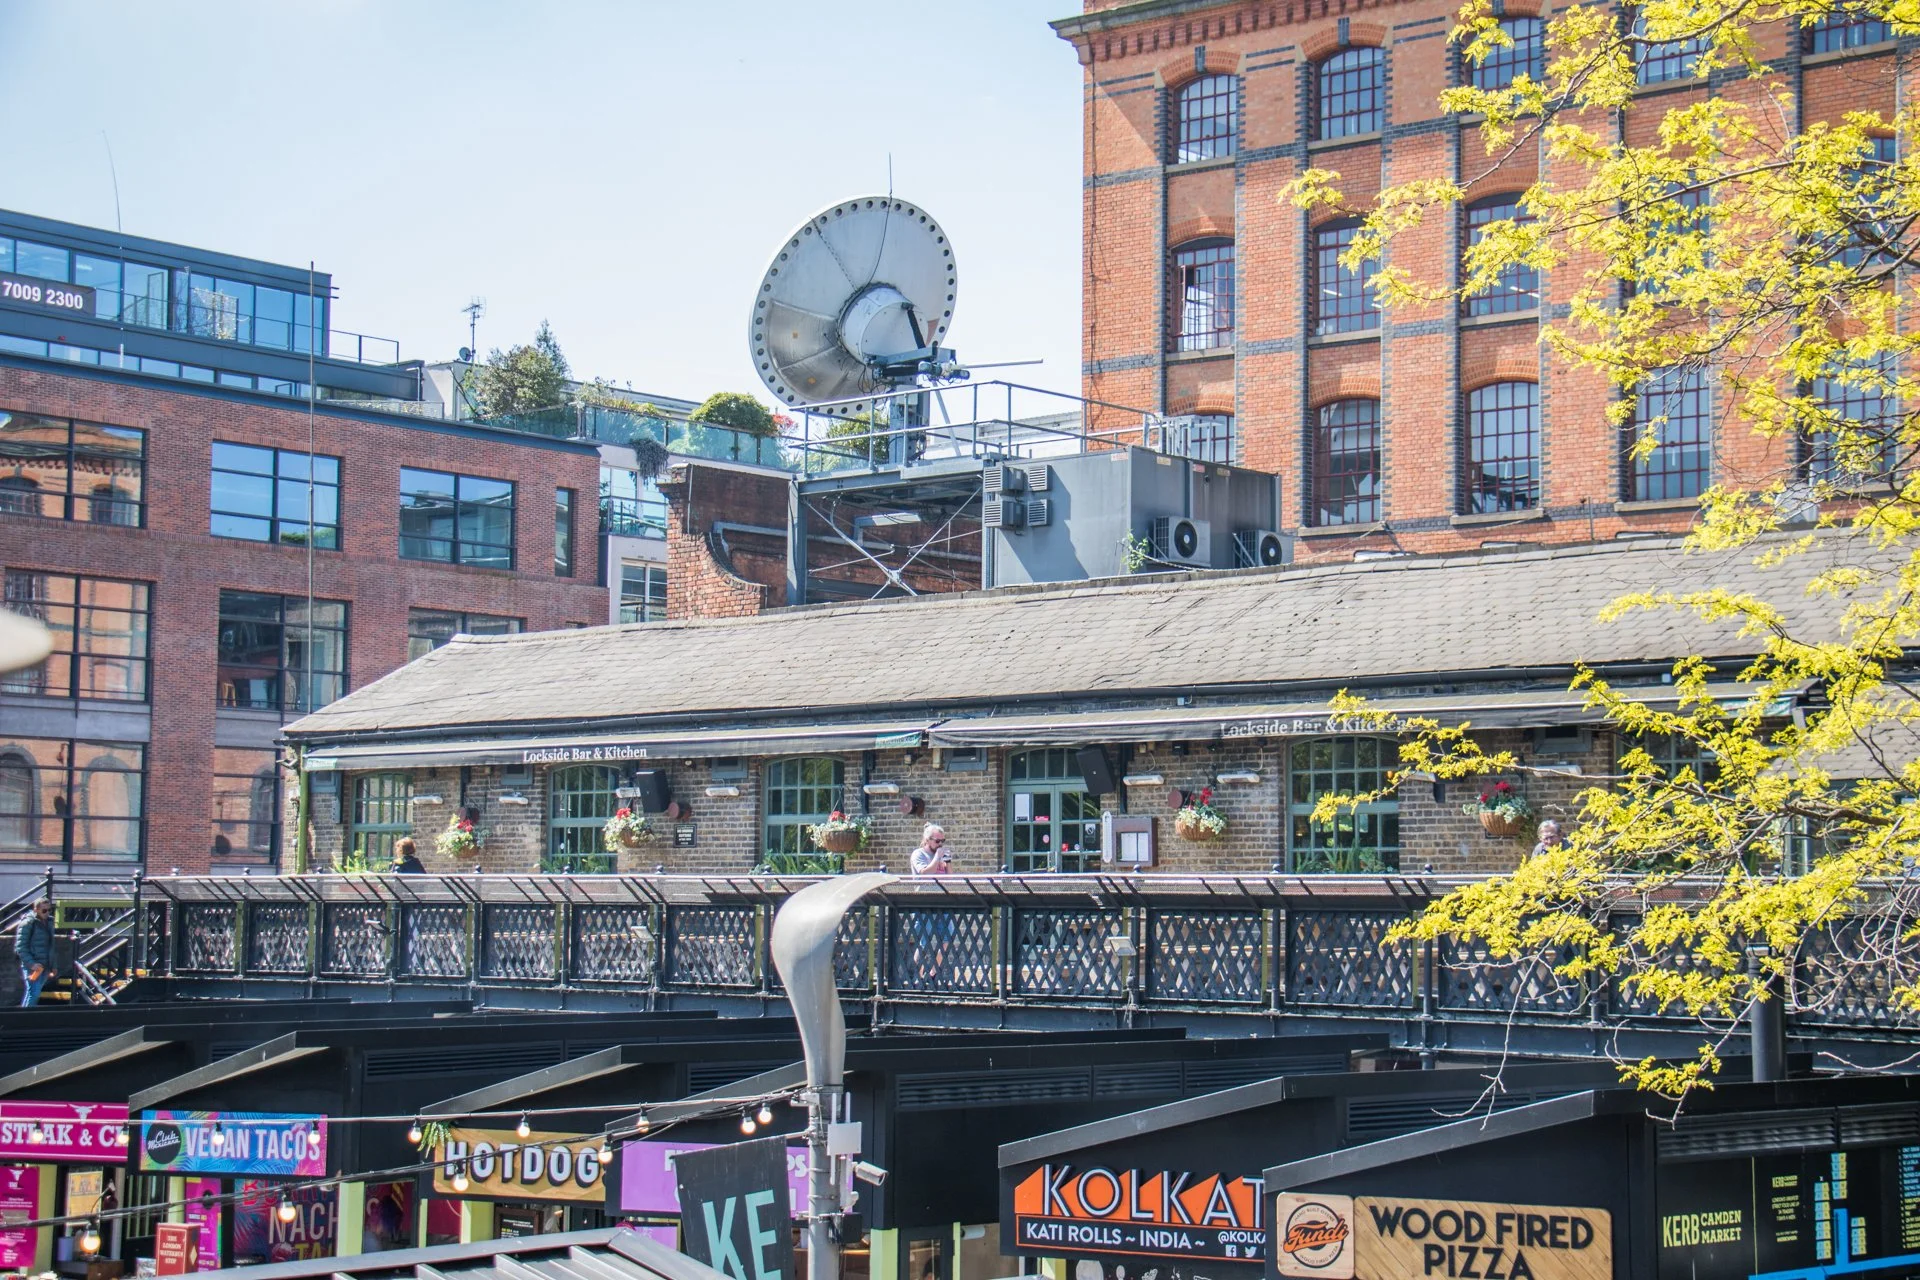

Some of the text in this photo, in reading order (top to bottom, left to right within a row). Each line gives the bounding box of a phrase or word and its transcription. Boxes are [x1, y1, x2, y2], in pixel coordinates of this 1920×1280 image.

[3, 281, 83, 309] 7009 2300
[1220, 717, 1406, 737] Lockside Bar & Kitcen
[523, 746, 647, 762] Lockside Bar & Kitchen
[79, 1128, 93, 1147] &
[155, 1130, 179, 1144] Club
[256, 1129, 321, 1161] TACOS
[1042, 1163, 1265, 1229] KOLKAT
[1370, 1205, 1594, 1250] WOOD FIRED
[1663, 1213, 1700, 1248] KERB
[1701, 1210, 1741, 1227] CAMDEN
[702, 1189, 782, 1280] KE
[1026, 1222, 1063, 1241] KATI
[1068, 1226, 1122, 1245] ROLLS
[1140, 1229, 1192, 1249] INDIA
[1701, 1227, 1741, 1244] MARKET
[1424, 1243, 1535, 1280] PIZZA
